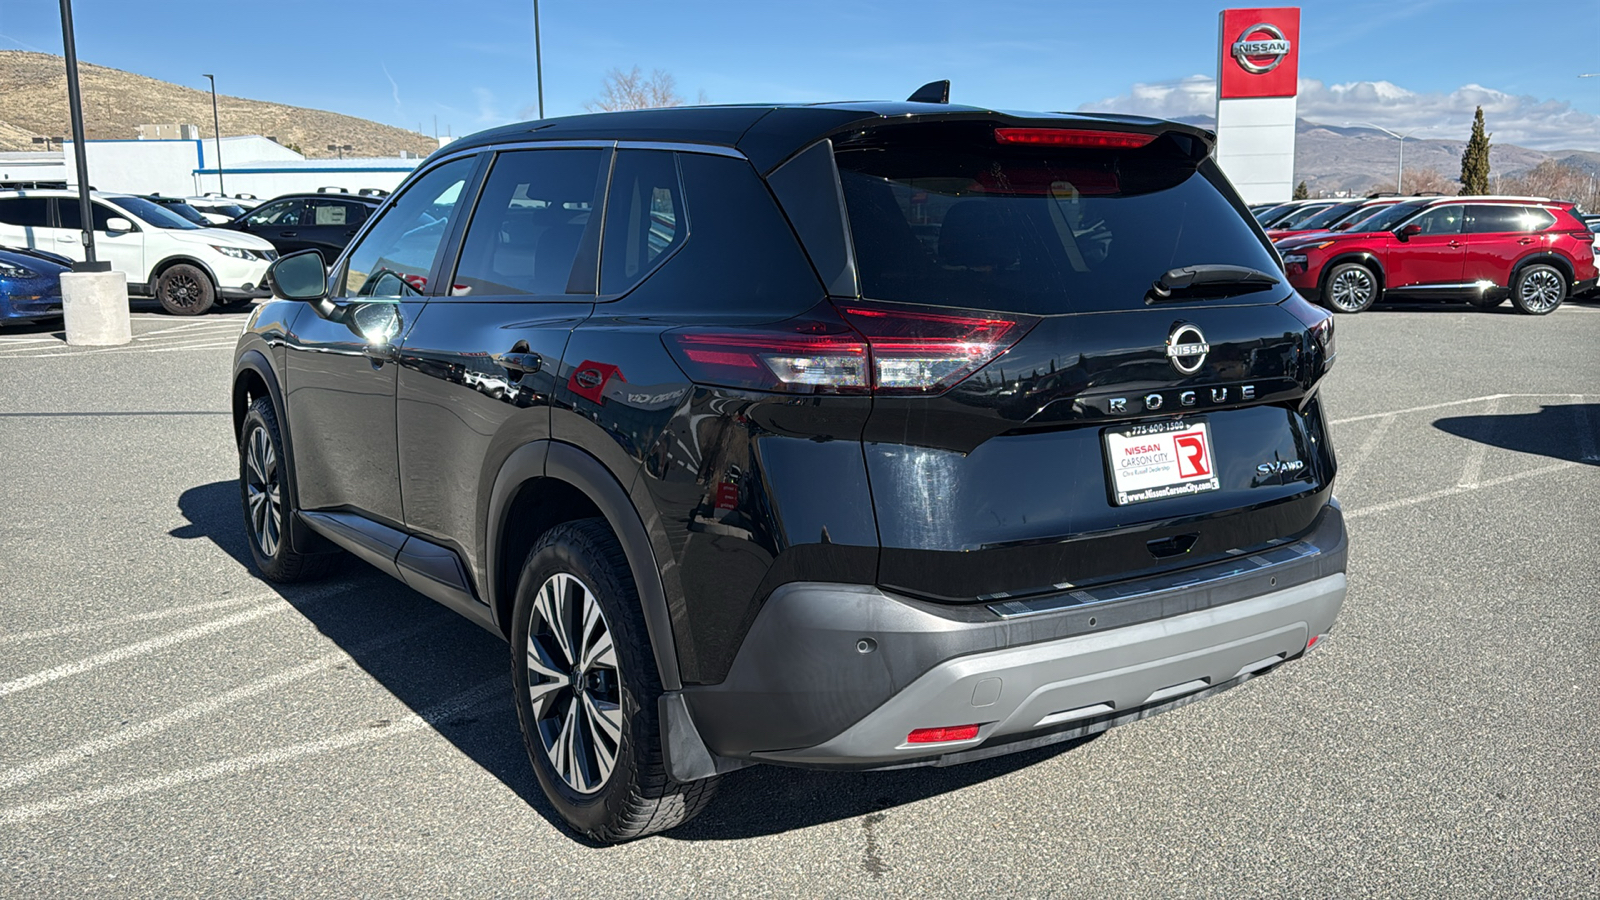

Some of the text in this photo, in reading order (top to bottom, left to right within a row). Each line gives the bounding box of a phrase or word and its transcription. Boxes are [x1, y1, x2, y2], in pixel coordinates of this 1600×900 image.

[1239, 42, 1286, 52] NISSAN
[1169, 344, 1210, 356] NISSAN
[1109, 385, 1255, 413] ROGUE
[1131, 421, 1184, 435] 775-600-1500
[1125, 443, 1161, 456] NISSAN
[1120, 452, 1168, 468] CARSON CITY
[1128, 482, 1211, 502] www.NissanCarsonCity.com
